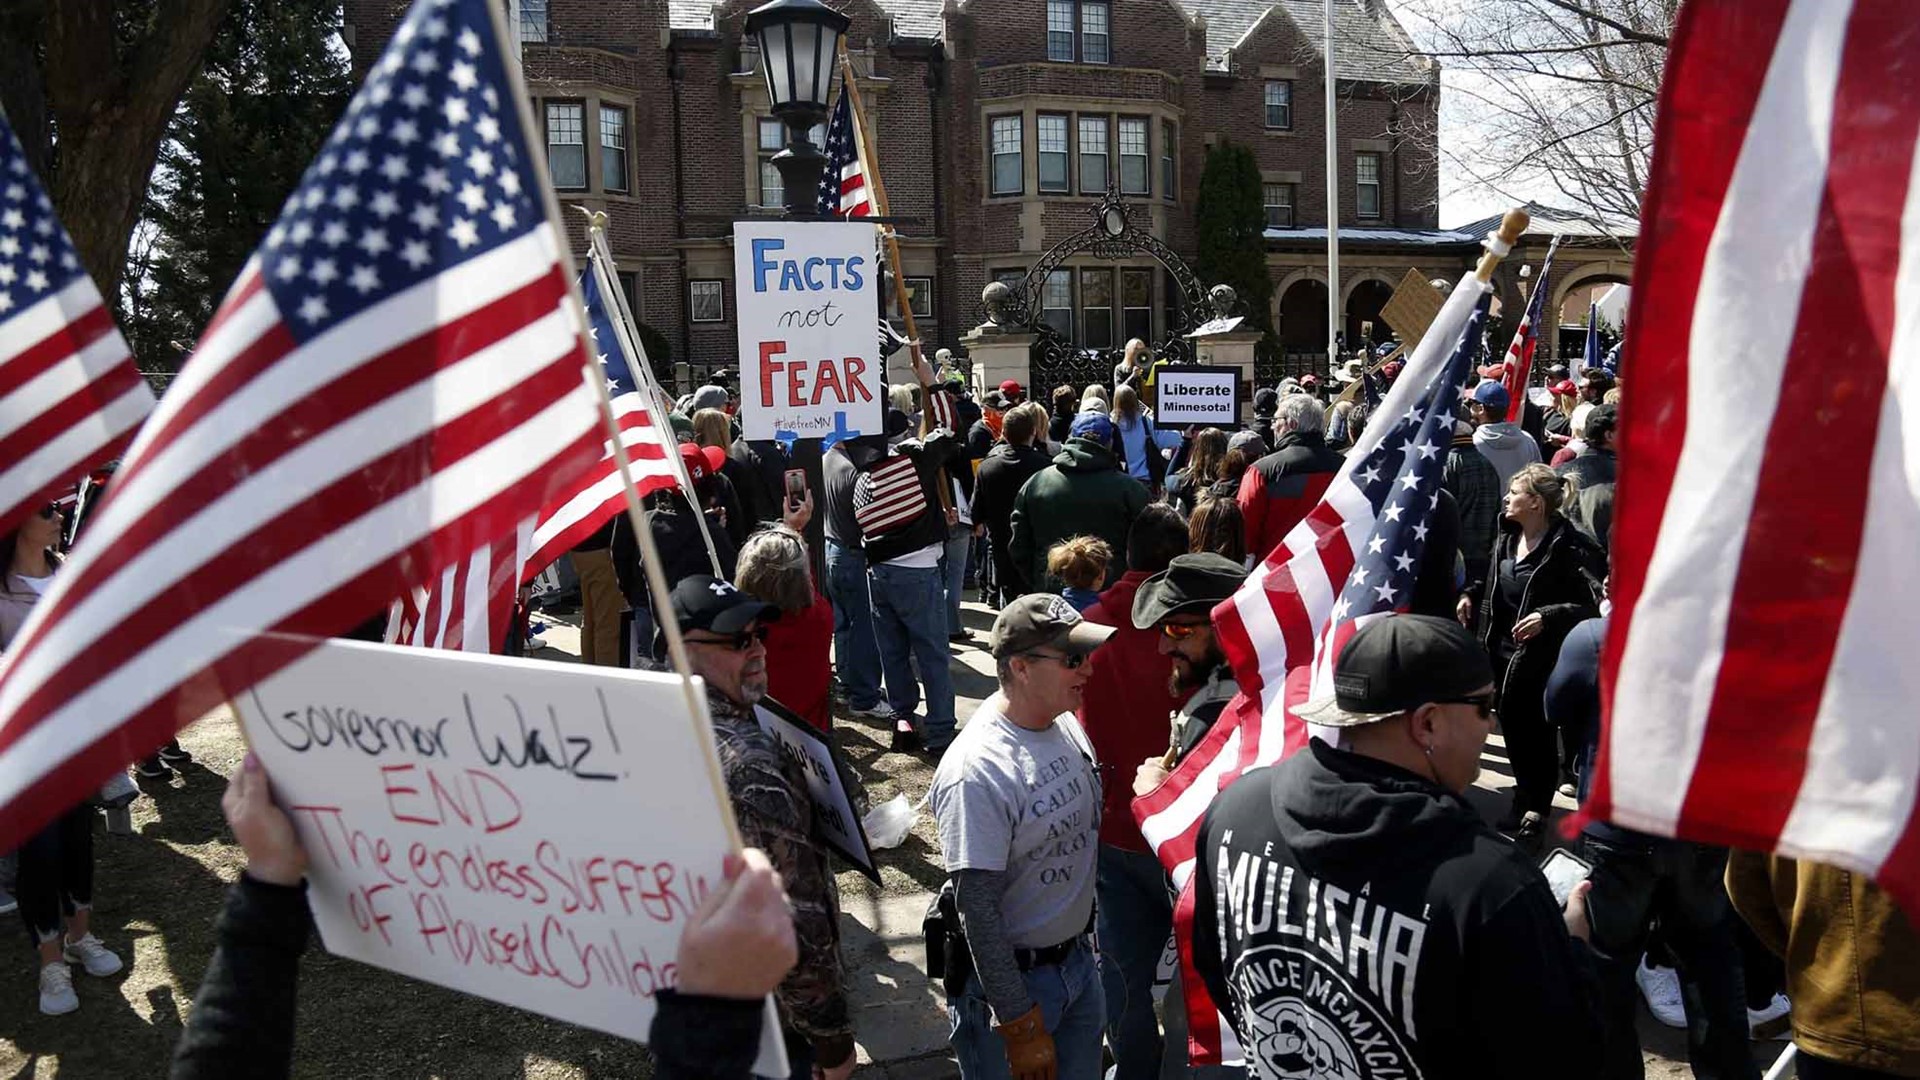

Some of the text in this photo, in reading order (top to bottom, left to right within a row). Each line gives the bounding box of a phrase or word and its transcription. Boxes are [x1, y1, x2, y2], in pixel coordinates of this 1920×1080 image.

[751, 238, 865, 293] FACTS
[778, 301, 845, 328] not
[759, 341, 873, 407] FEAR
[1163, 384, 1231, 396] Liberate
[1163, 402, 1231, 412] Minnesota!
[251, 686, 630, 782] Governor Walz!
[380, 763, 522, 834] END
[1032, 777, 1082, 818] CALM
[289, 805, 407, 884] The
[1040, 865, 1074, 885] ON
[541, 914, 678, 998] Childr
[1217, 846, 1427, 1041] MULISHA
[1240, 958, 1303, 1001] SINCE
[1306, 971, 1408, 1080] MCMXCI
